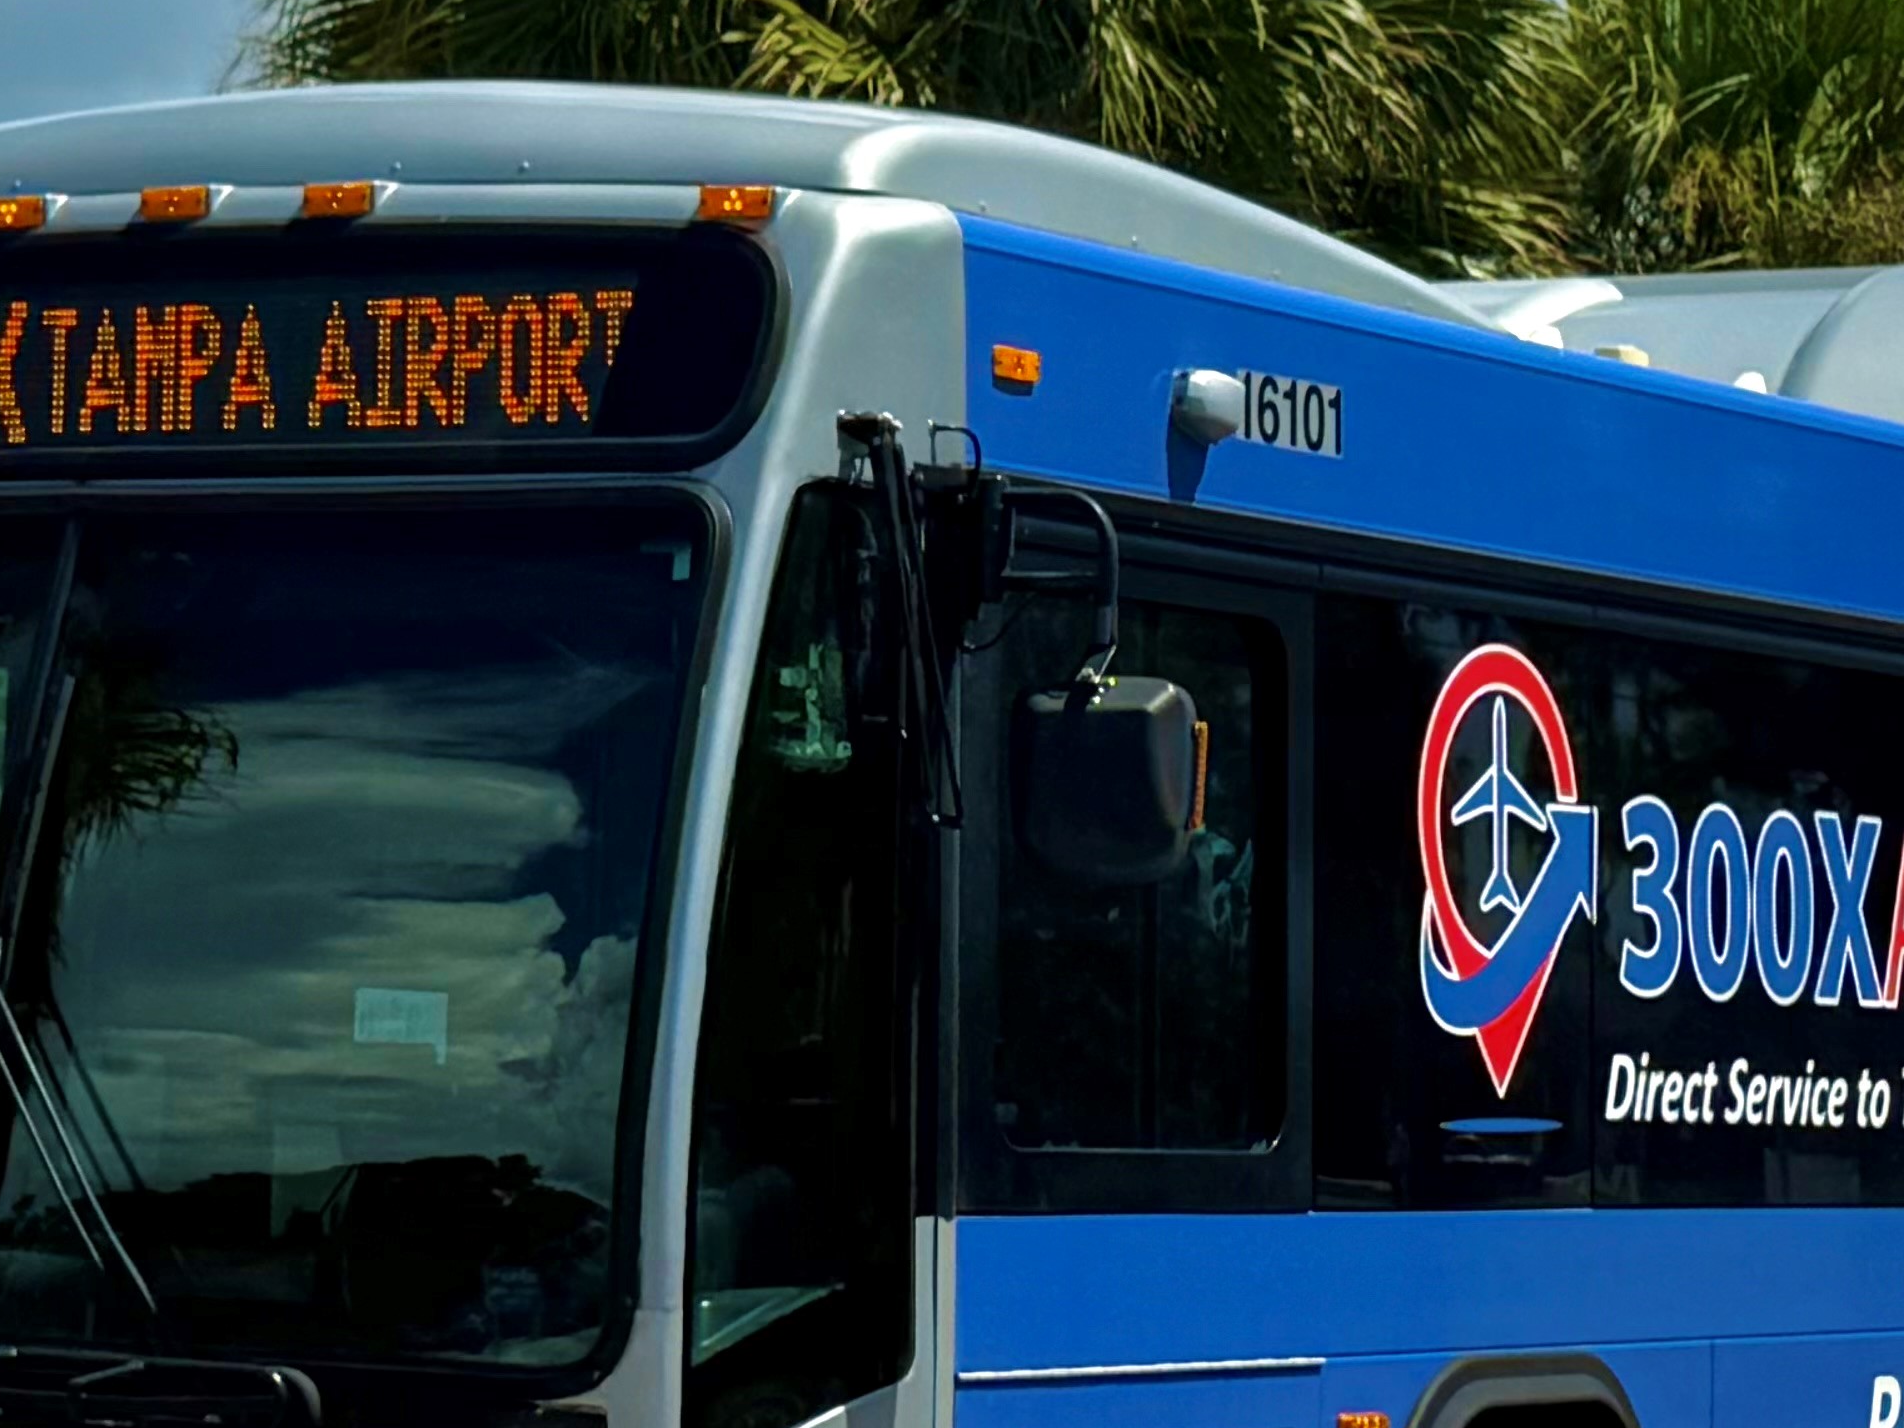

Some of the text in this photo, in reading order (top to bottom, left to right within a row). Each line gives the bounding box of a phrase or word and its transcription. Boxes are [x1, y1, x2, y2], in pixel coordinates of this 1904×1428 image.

[41, 302, 276, 434] TAMPA
[307, 289, 634, 428] AIRPORT
[1243, 371, 1342, 456] 16101
[1605, 1051, 1719, 1123] Direct
[1724, 1057, 1847, 1128] Service
[1857, 1068, 1891, 1129] to
